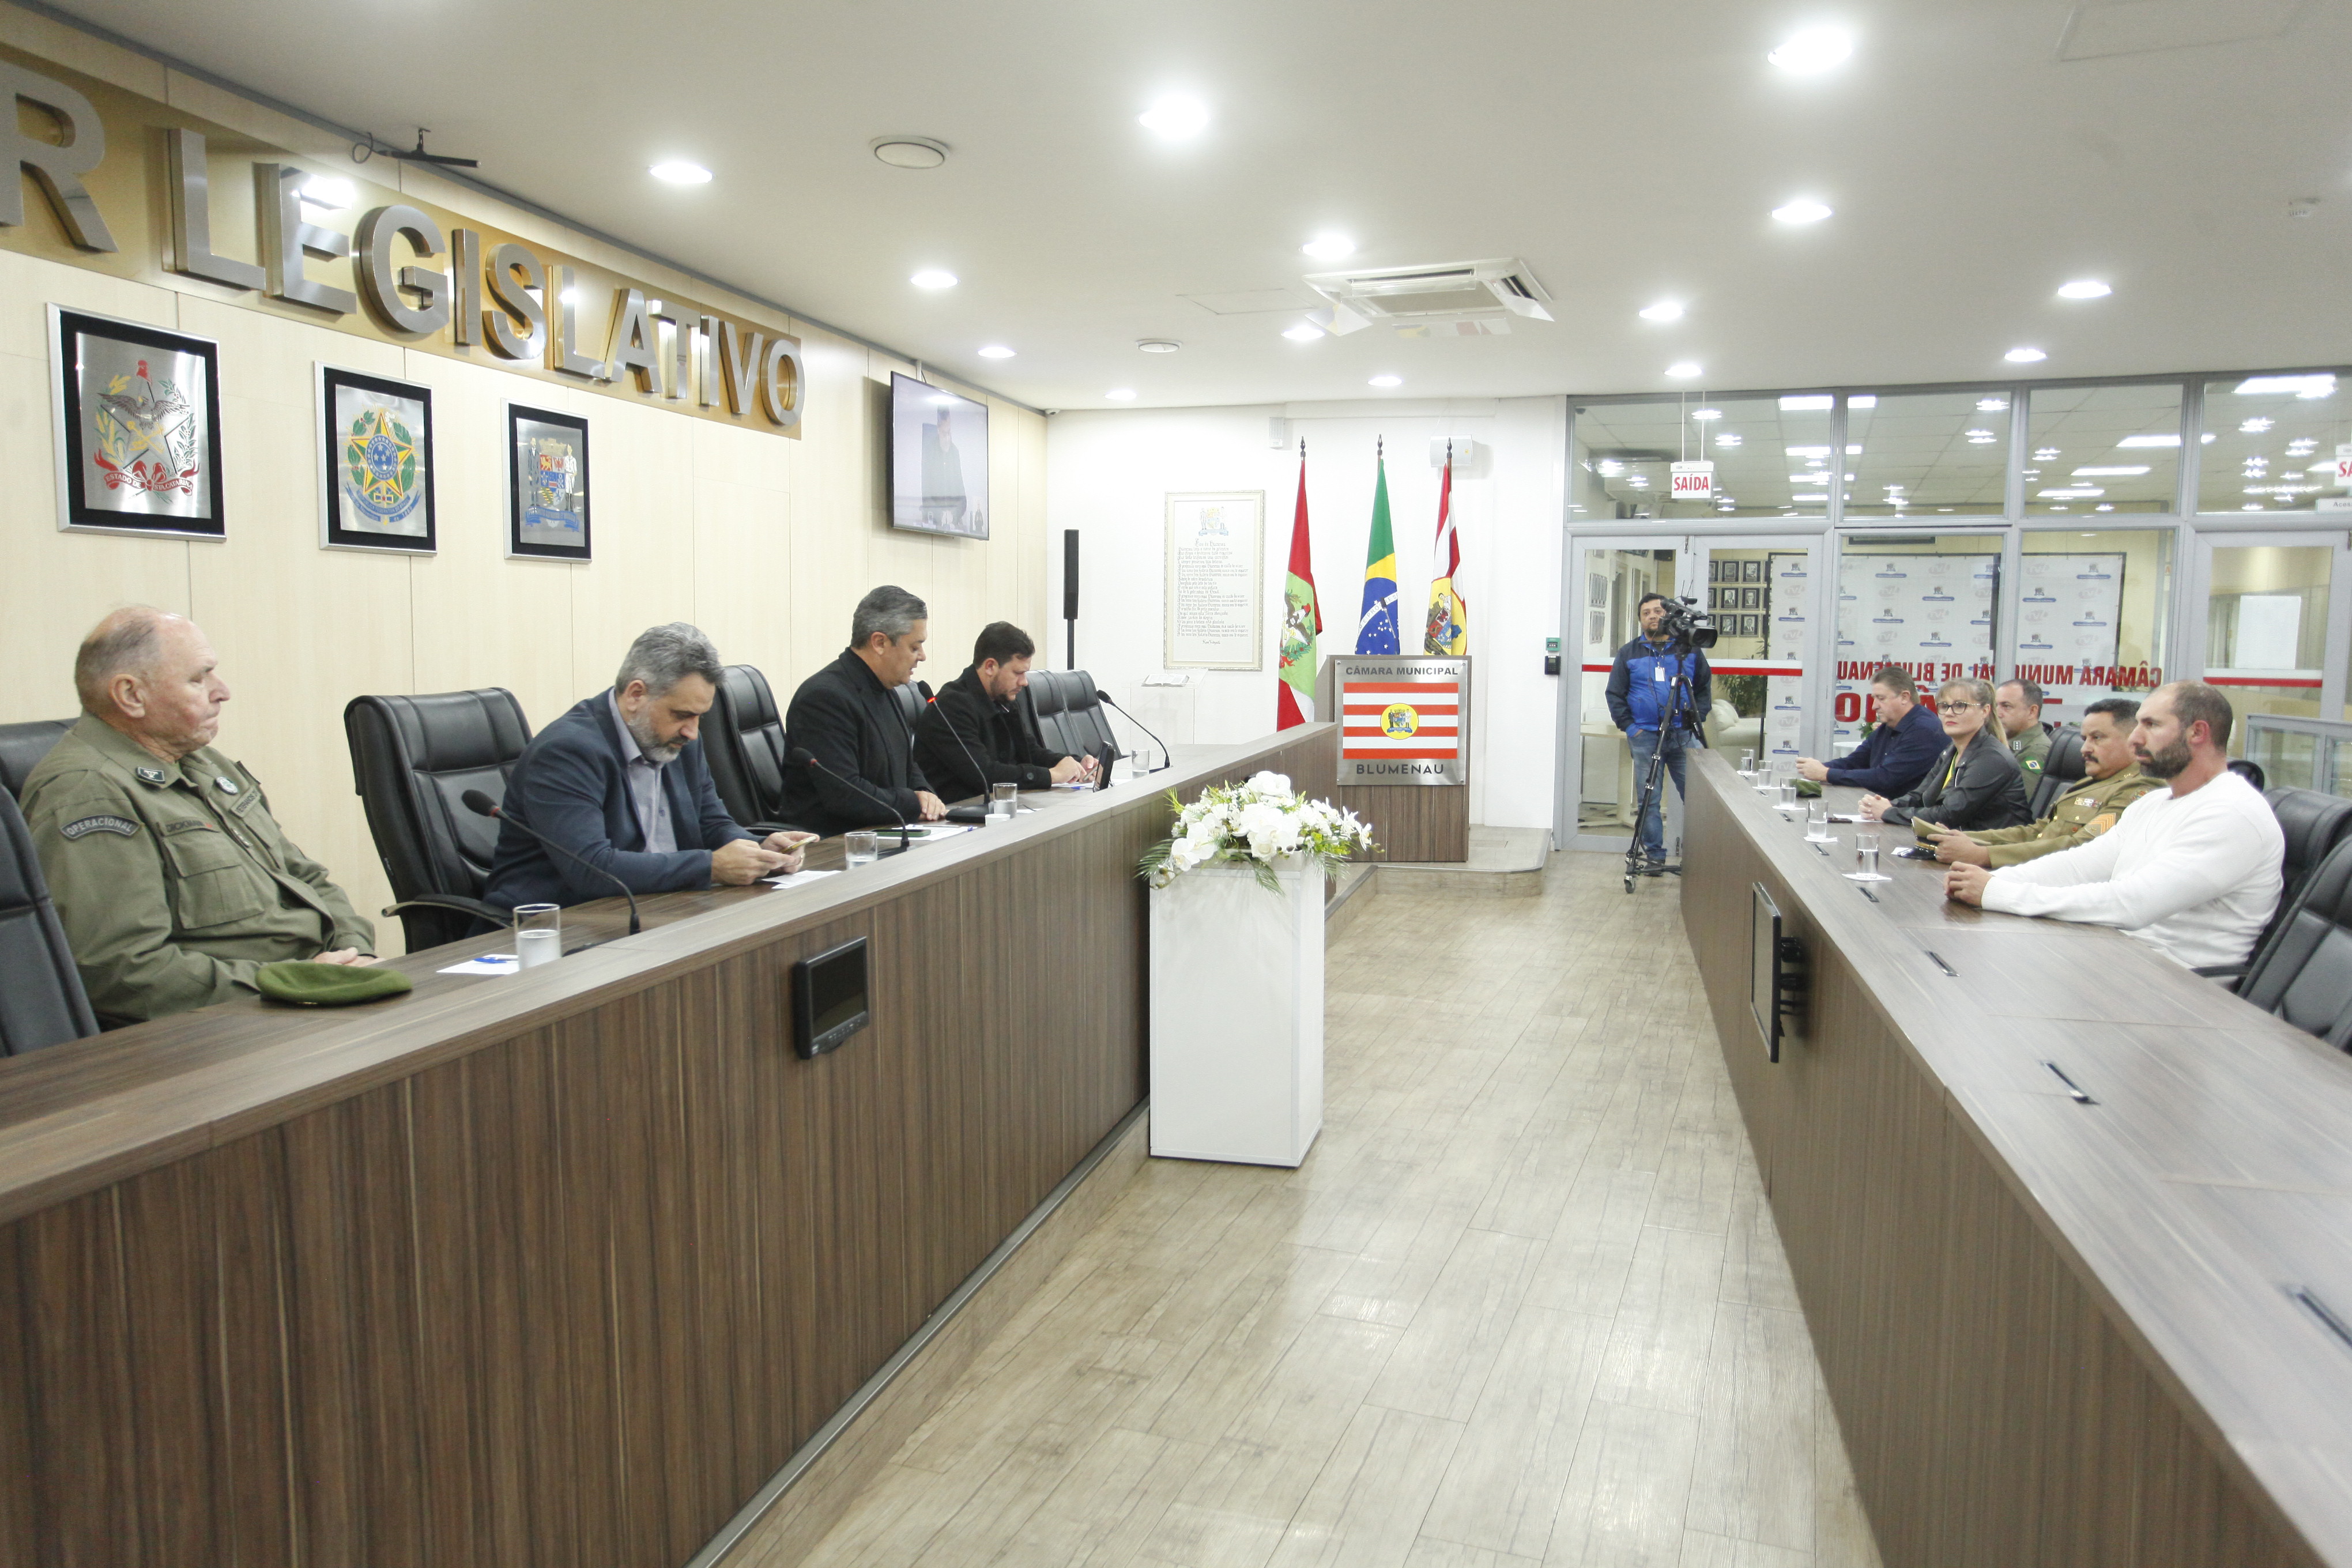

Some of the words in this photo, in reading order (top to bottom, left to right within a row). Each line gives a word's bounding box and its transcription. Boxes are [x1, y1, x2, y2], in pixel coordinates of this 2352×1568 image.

[162, 127, 805, 428] LEGISLATIVO
[105, 473, 132, 484] ESTADO
[132, 480, 142, 488] DE
[1673, 473, 1709, 491] SAÍDA
[1345, 665, 1392, 675] CÂMARA
[1396, 667, 1458, 675] MUNICIPAL
[1356, 764, 1443, 774] BLUMENAU
[66, 817, 133, 835] OPERACIONAL
